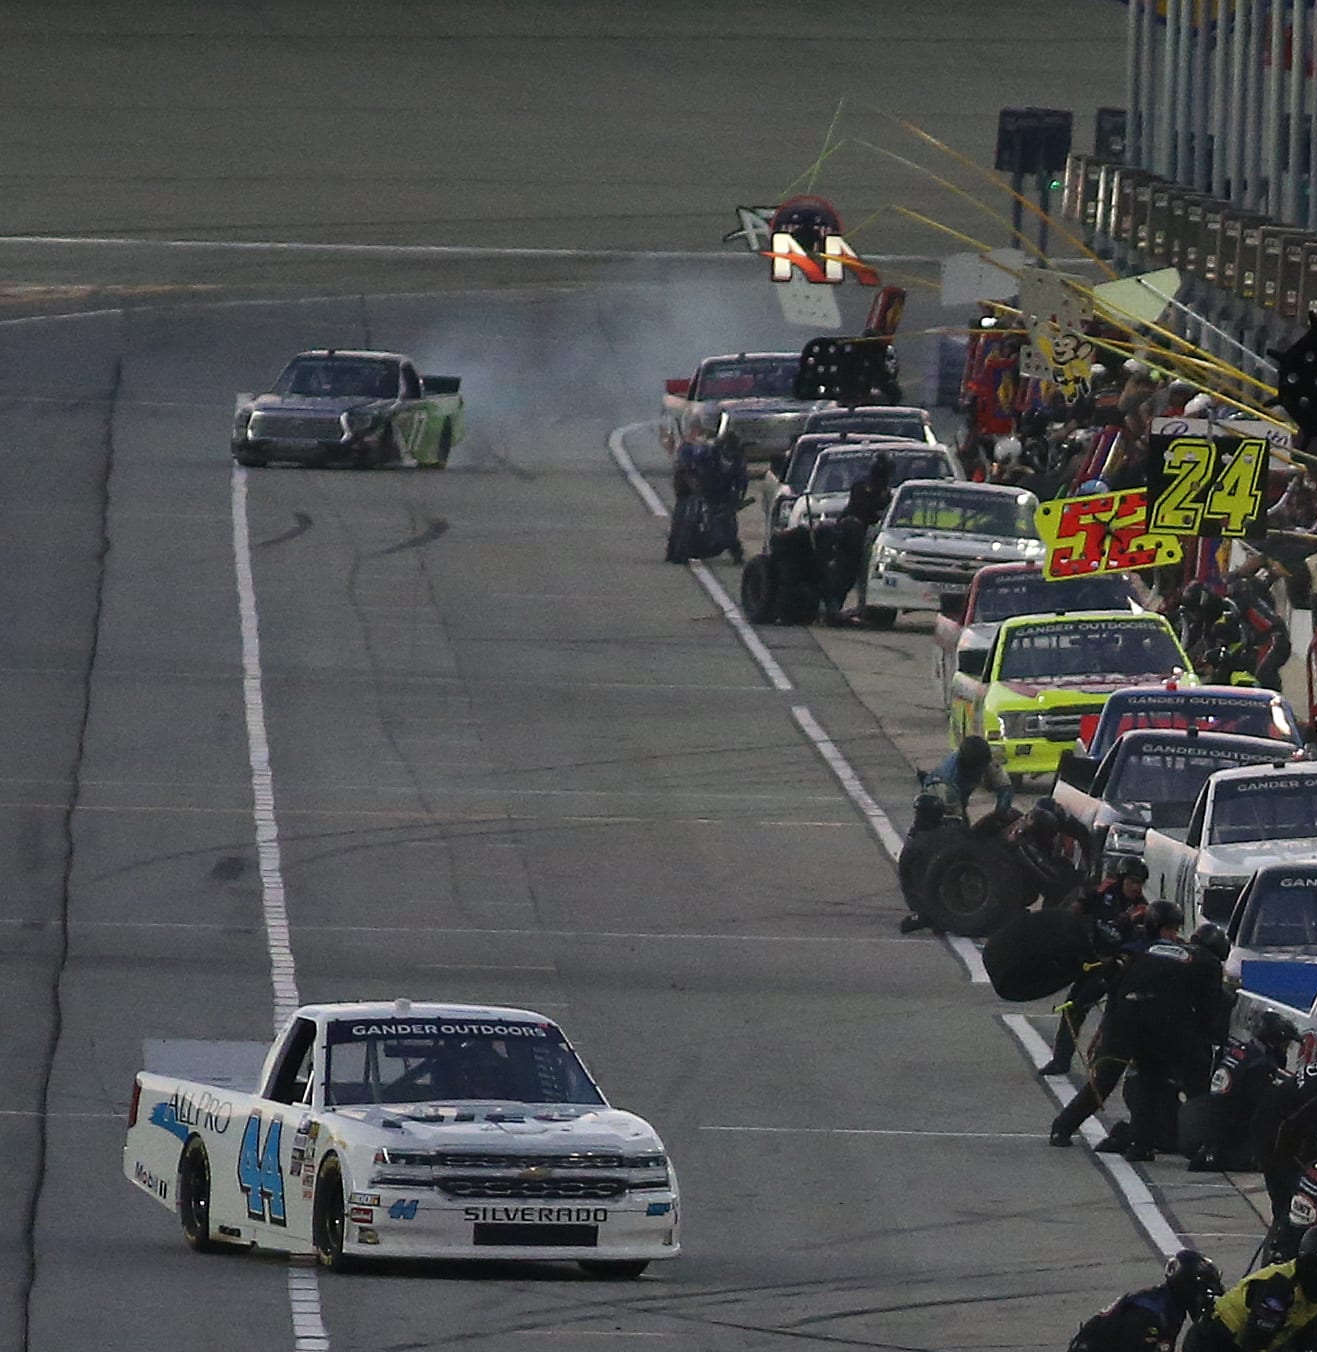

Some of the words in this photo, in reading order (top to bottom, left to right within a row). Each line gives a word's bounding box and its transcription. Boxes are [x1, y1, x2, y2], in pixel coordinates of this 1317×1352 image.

[1150, 438, 1266, 536] 24
[1050, 492, 1158, 577] 52
[1237, 779, 1299, 792] GANDER
[352, 1024, 437, 1037] GANDER
[441, 1023, 547, 1039] OUTDOORS
[237, 1108, 288, 1227] 44
[464, 1206, 607, 1222] SILVERADO
